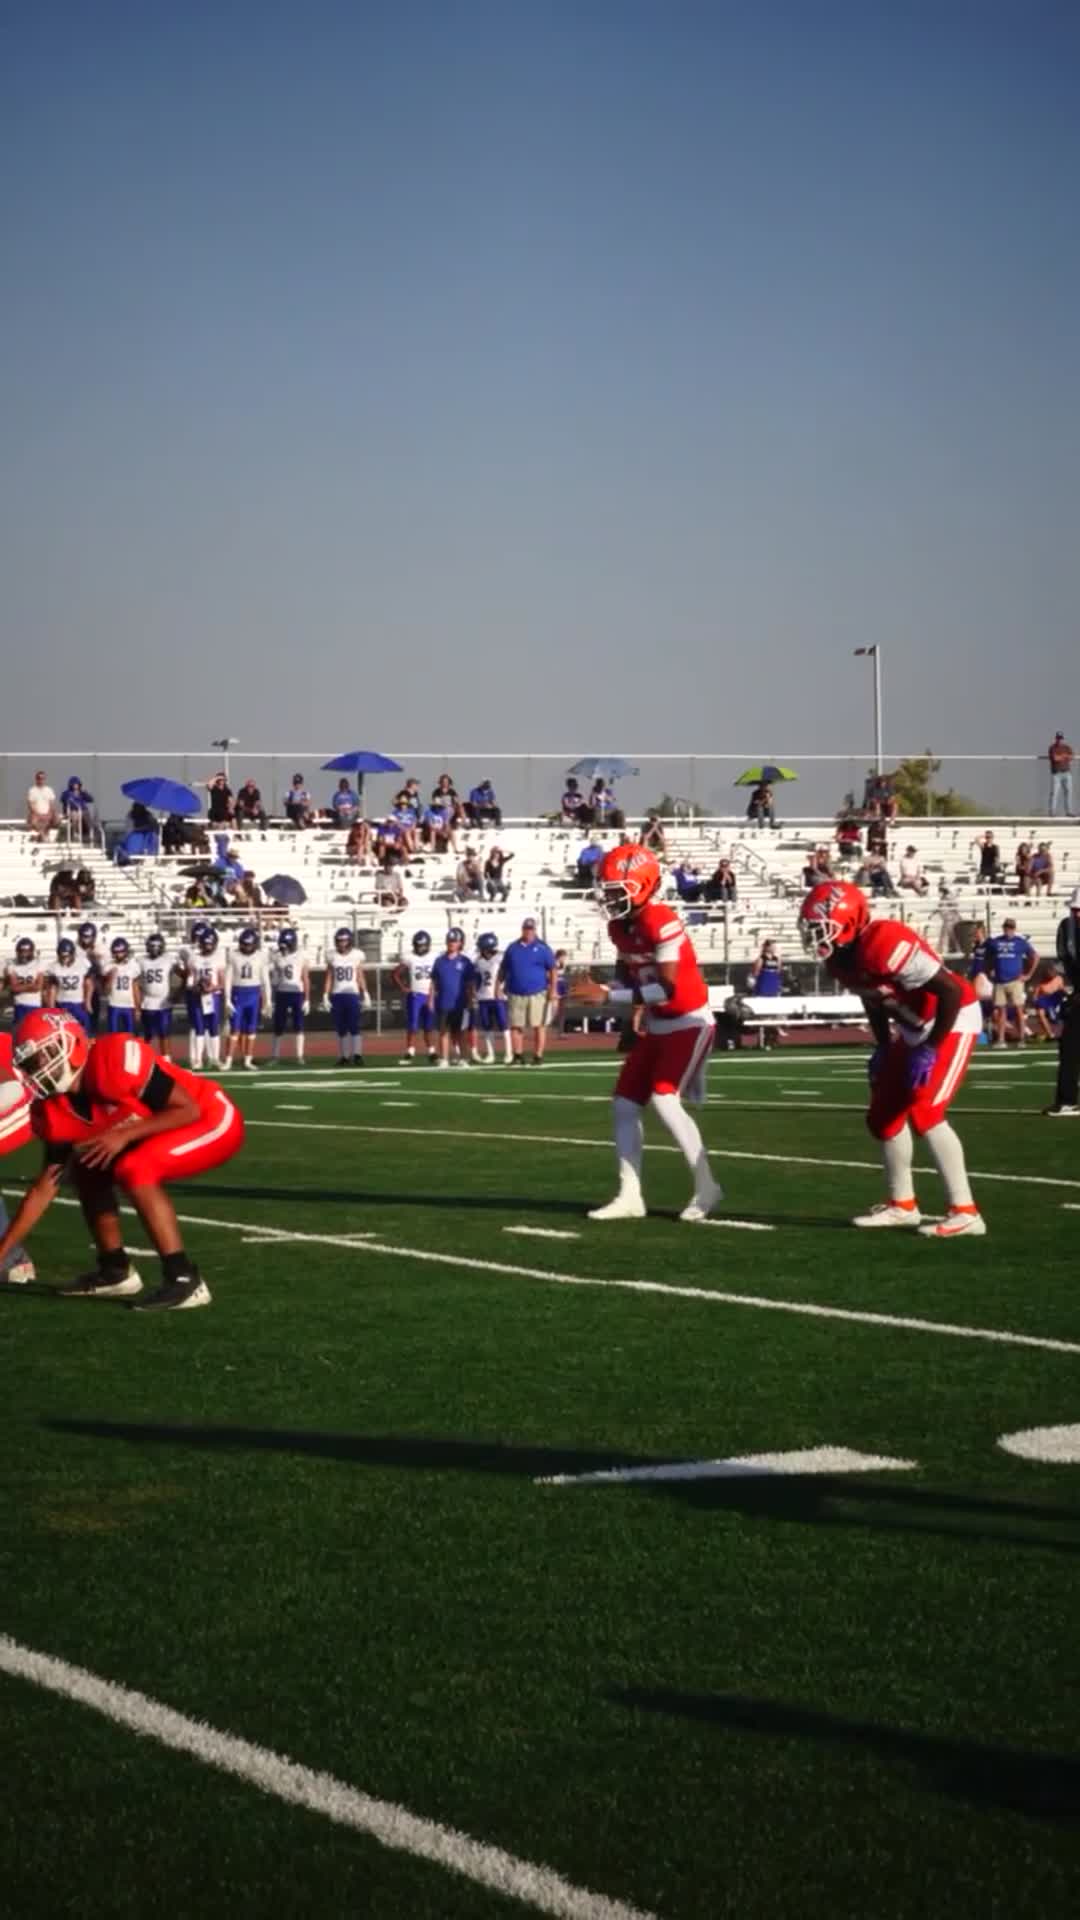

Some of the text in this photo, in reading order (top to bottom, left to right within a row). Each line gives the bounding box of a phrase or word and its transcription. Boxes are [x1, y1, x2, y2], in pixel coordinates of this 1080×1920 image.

[146, 968, 164, 984] 65
[241, 965, 253, 979] 11
[336, 966, 353, 981] 80
[62, 975, 80, 991] 52
